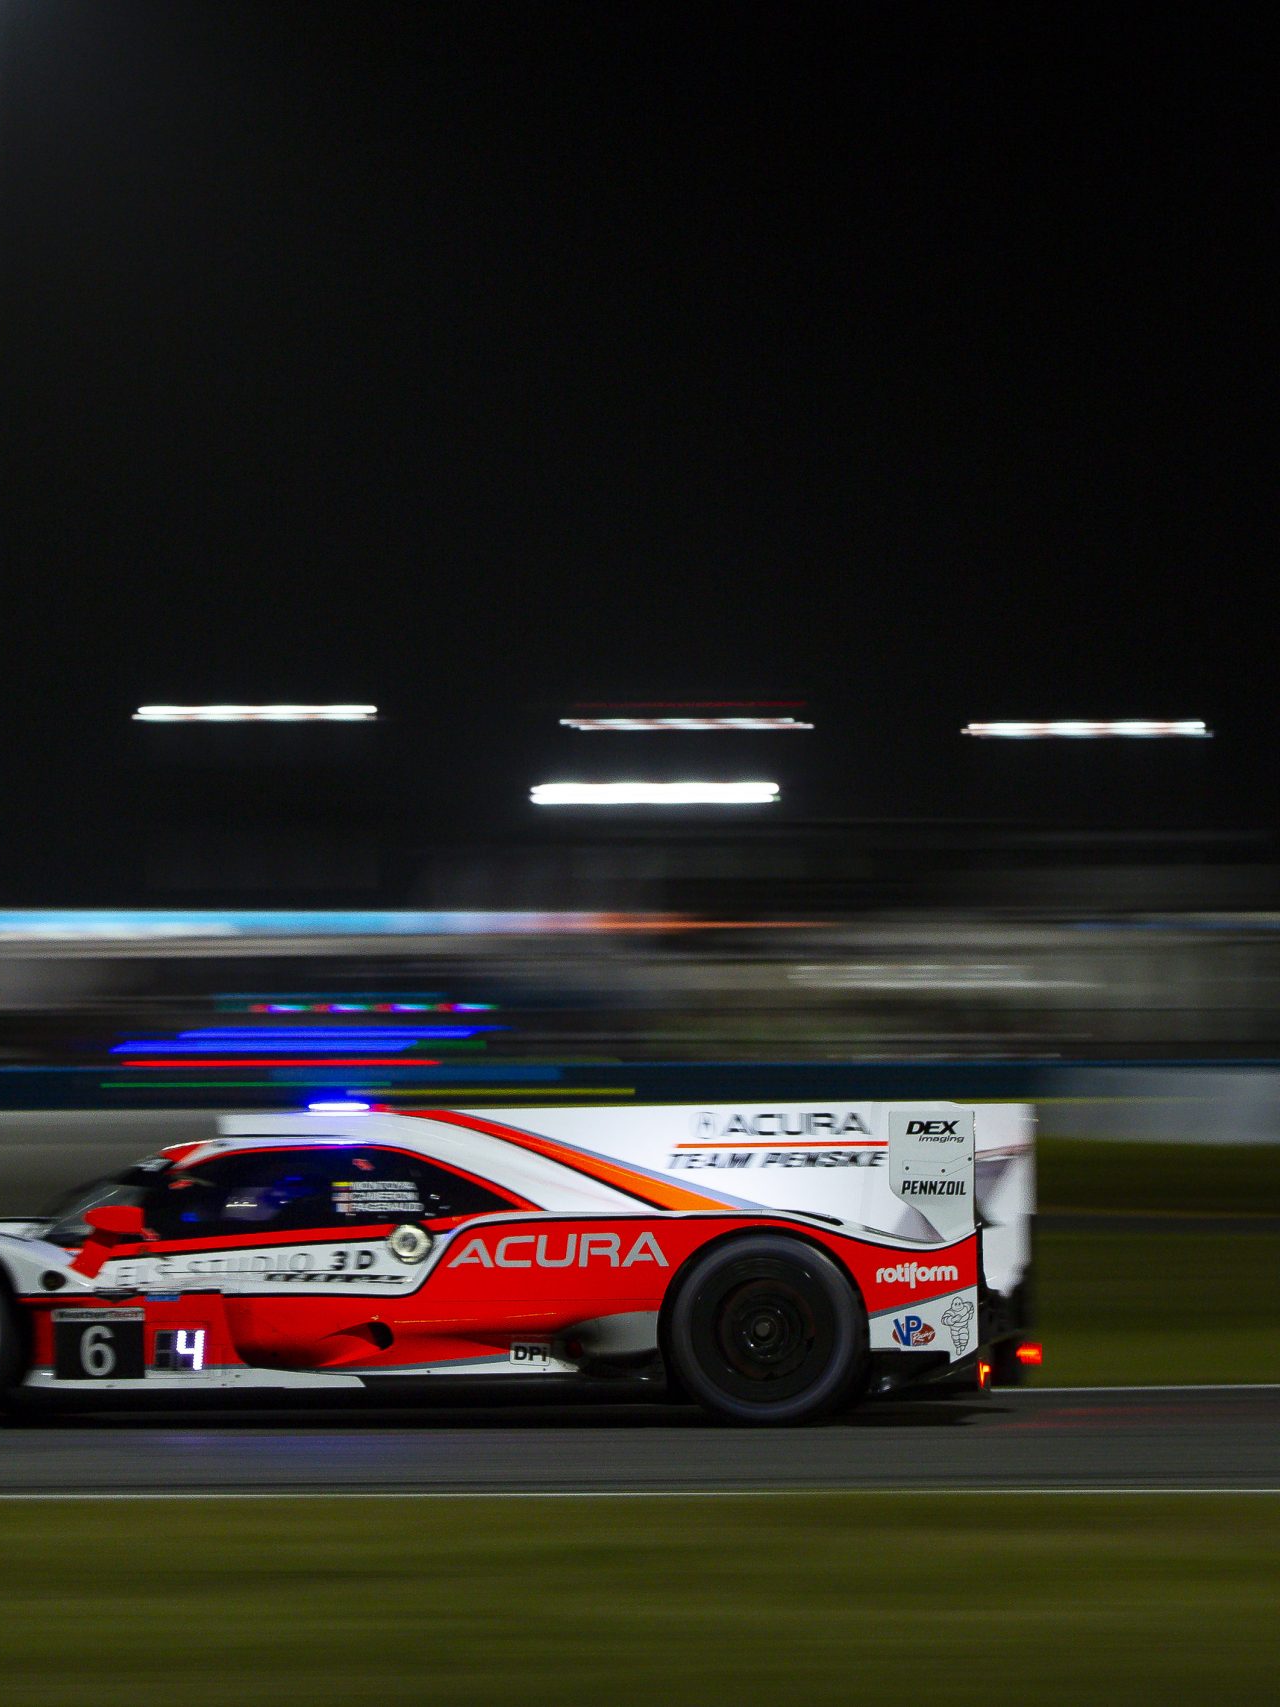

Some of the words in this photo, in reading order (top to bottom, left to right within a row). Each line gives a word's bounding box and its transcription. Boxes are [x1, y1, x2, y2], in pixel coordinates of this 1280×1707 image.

[722, 1112, 871, 1136] ACURA
[906, 1120, 960, 1135] DEX
[919, 1135, 964, 1143] imaging
[668, 1152, 753, 1169] TEAM
[762, 1151, 889, 1168] PENSKE
[901, 1180, 966, 1195] PENNZOIL
[330, 1250, 376, 1271] 3D
[447, 1231, 670, 1268] ACURA
[876, 1262, 958, 1289] rotiform
[893, 1315, 922, 1346] VP
[80, 1325, 117, 1377] 6
[176, 1330, 205, 1370] 4
[514, 1346, 546, 1361] DPi
